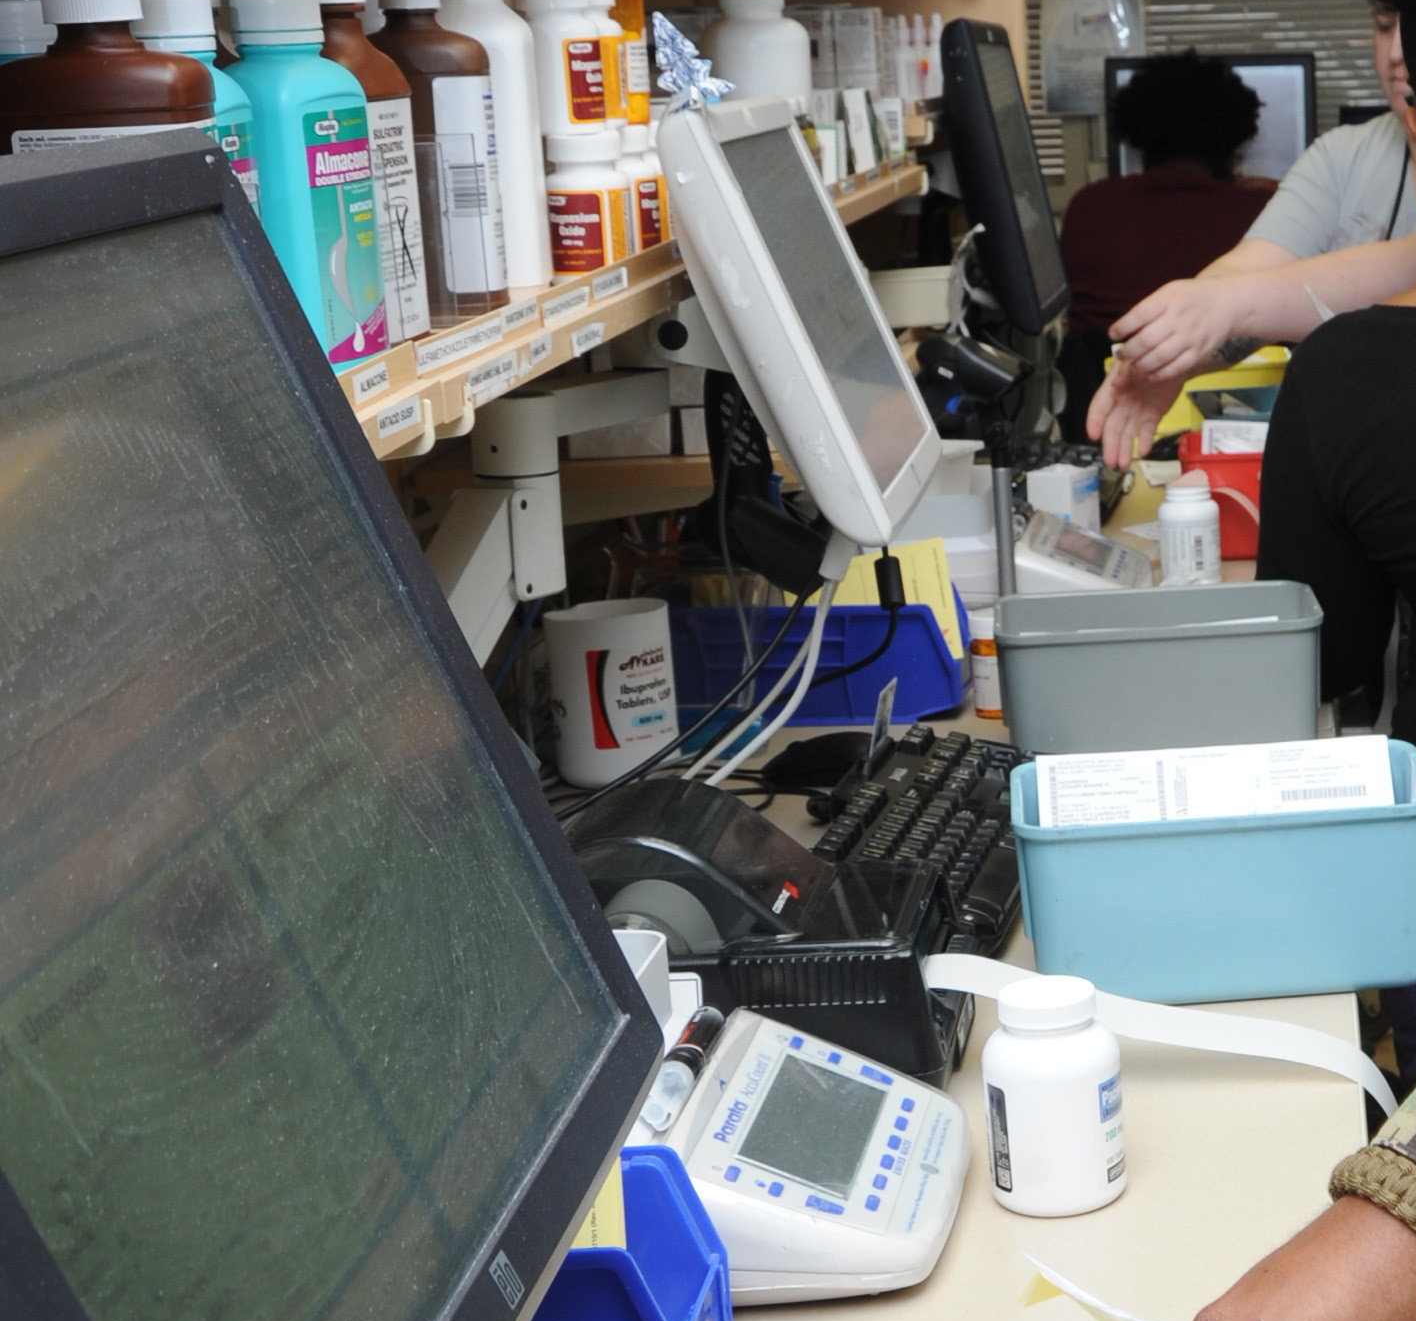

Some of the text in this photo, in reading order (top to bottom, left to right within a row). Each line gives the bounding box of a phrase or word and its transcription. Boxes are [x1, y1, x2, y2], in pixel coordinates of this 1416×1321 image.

[315, 150, 370, 176] Almacone
[558, 226, 586, 238] Oxide
[620, 677, 666, 695] Ibuprofen
[658, 687, 671, 701] USP
[713, 1099, 749, 1144] Parata
